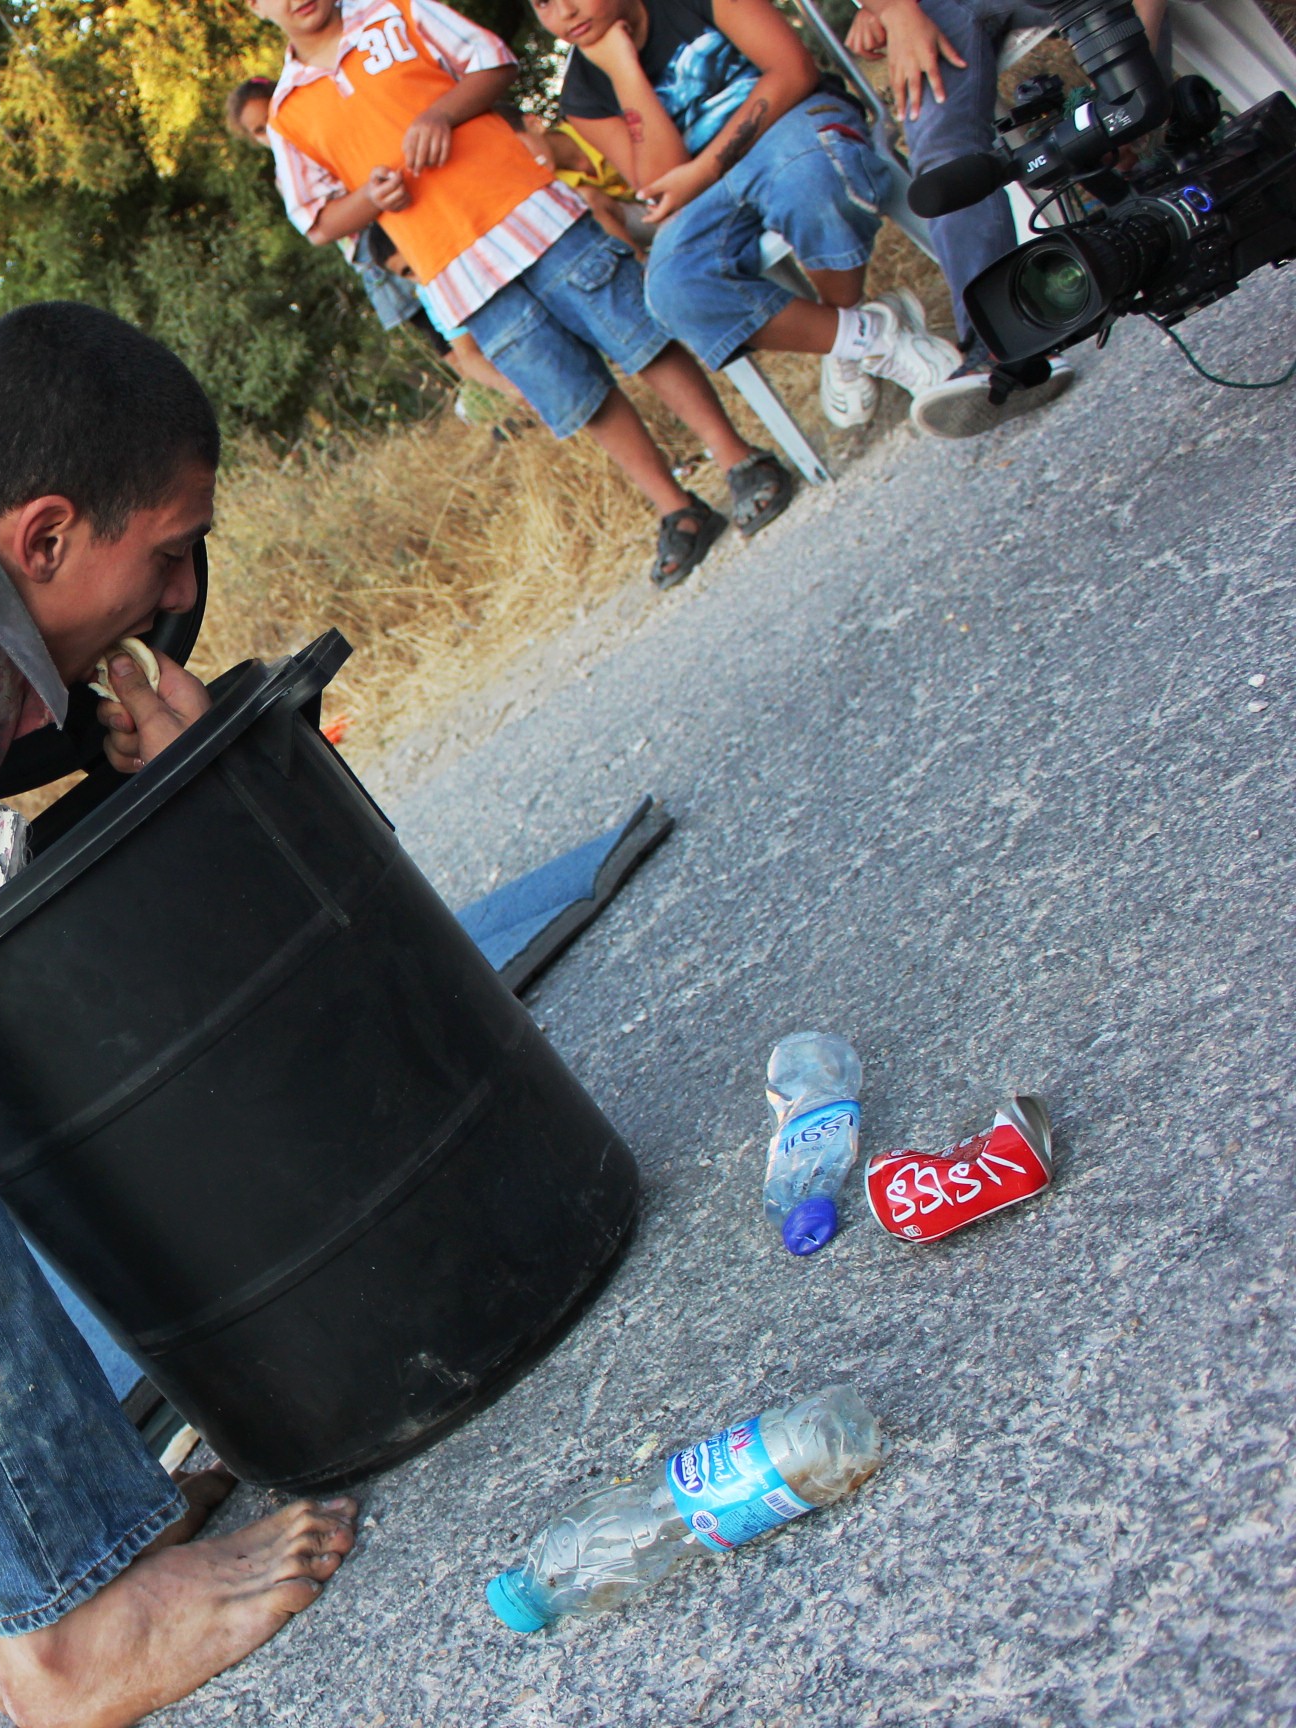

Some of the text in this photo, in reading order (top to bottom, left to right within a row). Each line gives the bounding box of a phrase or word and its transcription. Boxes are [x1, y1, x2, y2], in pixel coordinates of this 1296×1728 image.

[357, 17, 418, 75] 30
[1026, 154, 1047, 174] JVC
[712, 1448, 731, 1483] Pure
